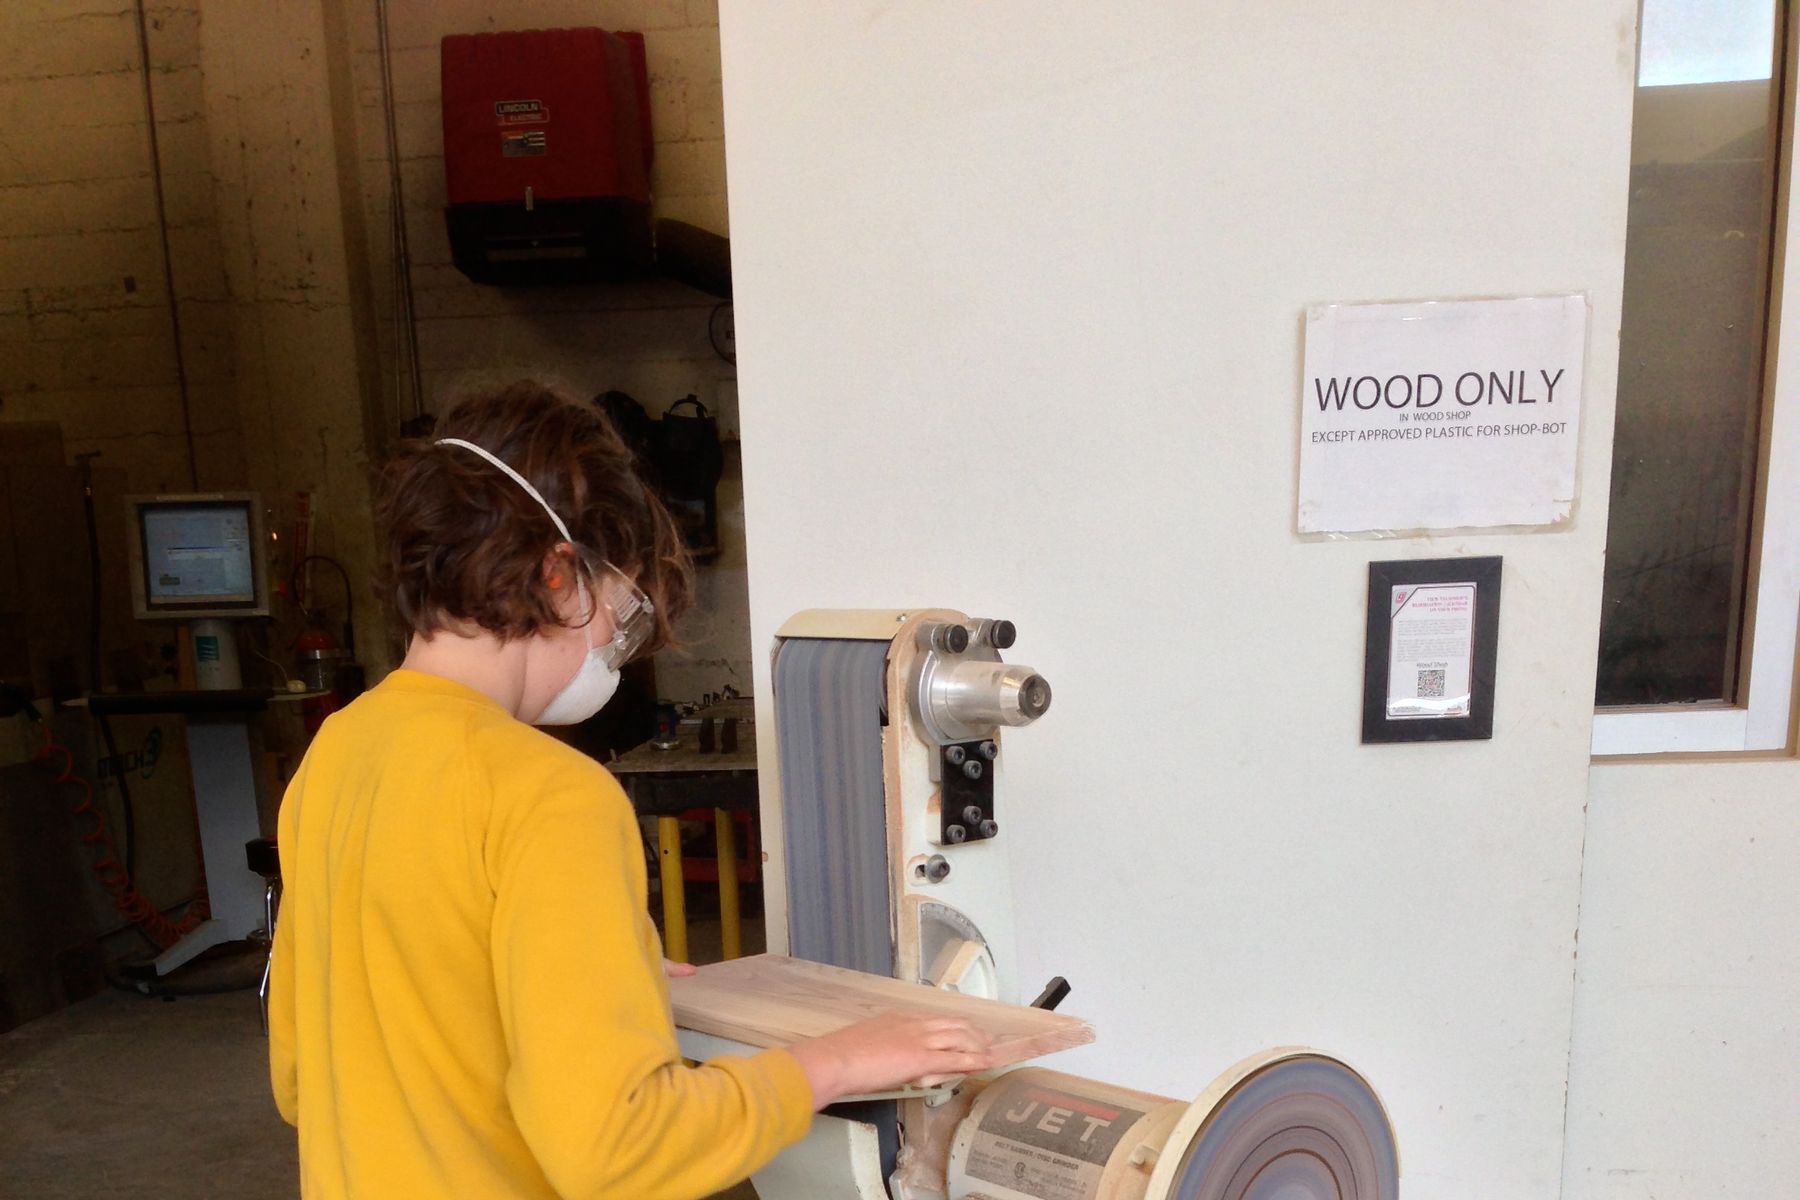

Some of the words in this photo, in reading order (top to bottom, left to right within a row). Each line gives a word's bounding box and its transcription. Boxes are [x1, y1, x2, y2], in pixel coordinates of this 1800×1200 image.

[498, 103, 538, 113] LINCOLN
[1315, 373, 1443, 411] WOOD
[1455, 369, 1565, 406] ONLY
[1399, 412, 1409, 421] IN
[1413, 411, 1444, 421] WOOD
[1446, 410, 1471, 420] SHOP
[1311, 430, 1354, 443] EXCEPT
[1358, 428, 1422, 441] APPROVED
[1425, 425, 1473, 439] PLASTIC
[1476, 424, 1501, 437] FOR
[1504, 422, 1567, 436] SHOP-BOT
[1006, 1101, 1111, 1143] JET
